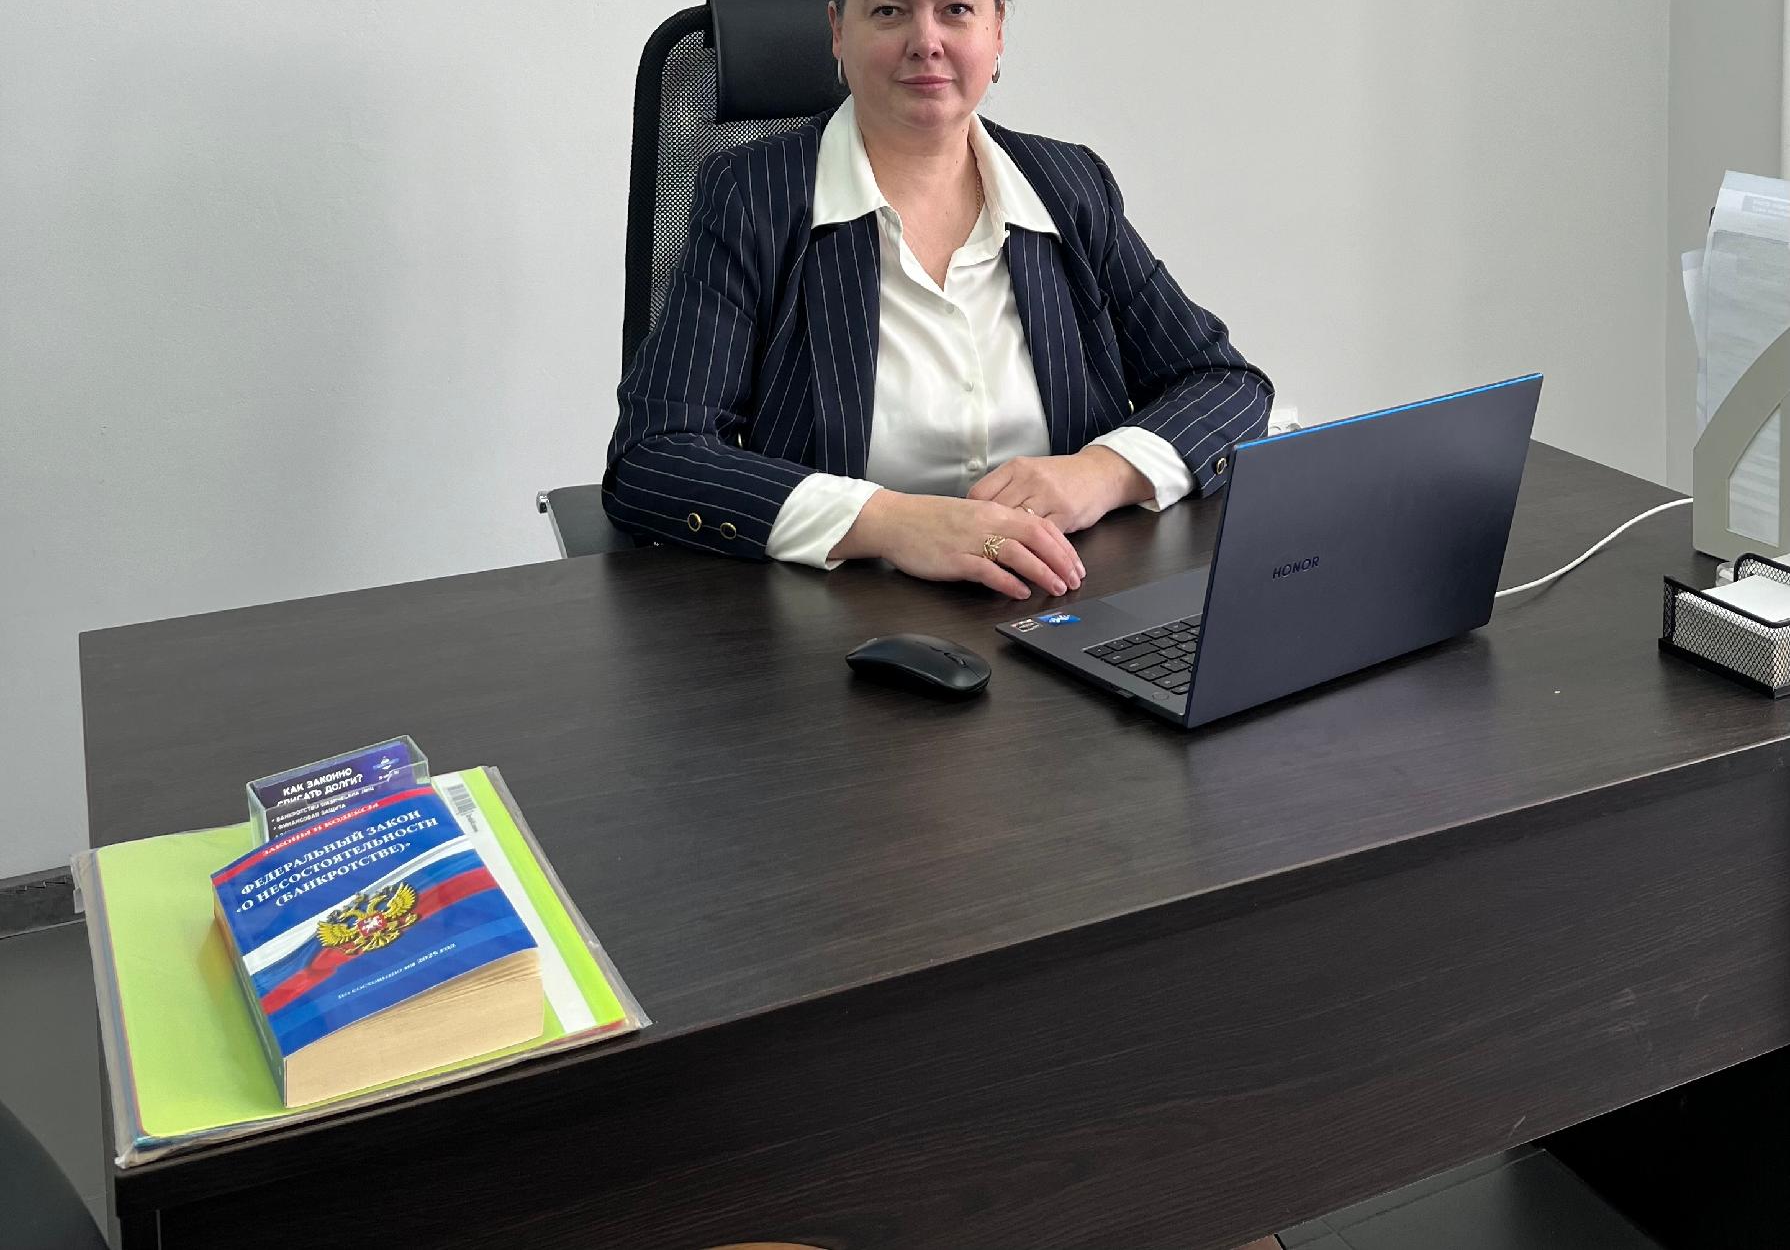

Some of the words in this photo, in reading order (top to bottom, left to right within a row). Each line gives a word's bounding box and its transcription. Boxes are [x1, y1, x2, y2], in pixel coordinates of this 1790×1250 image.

[1272, 556, 1320, 579] HONOR
[282, 783, 305, 797] КАК
[306, 767, 353, 789] ЗАКОННО
[325, 773, 364, 795] ДОЛГИ?
[241, 830, 364, 895] ФЕДЕРАЛЬНЫЙ
[366, 810, 421, 835] ЗАКОН
[255, 817, 439, 903] НЕСОСТОЯТЕЛЬНОСТИ
